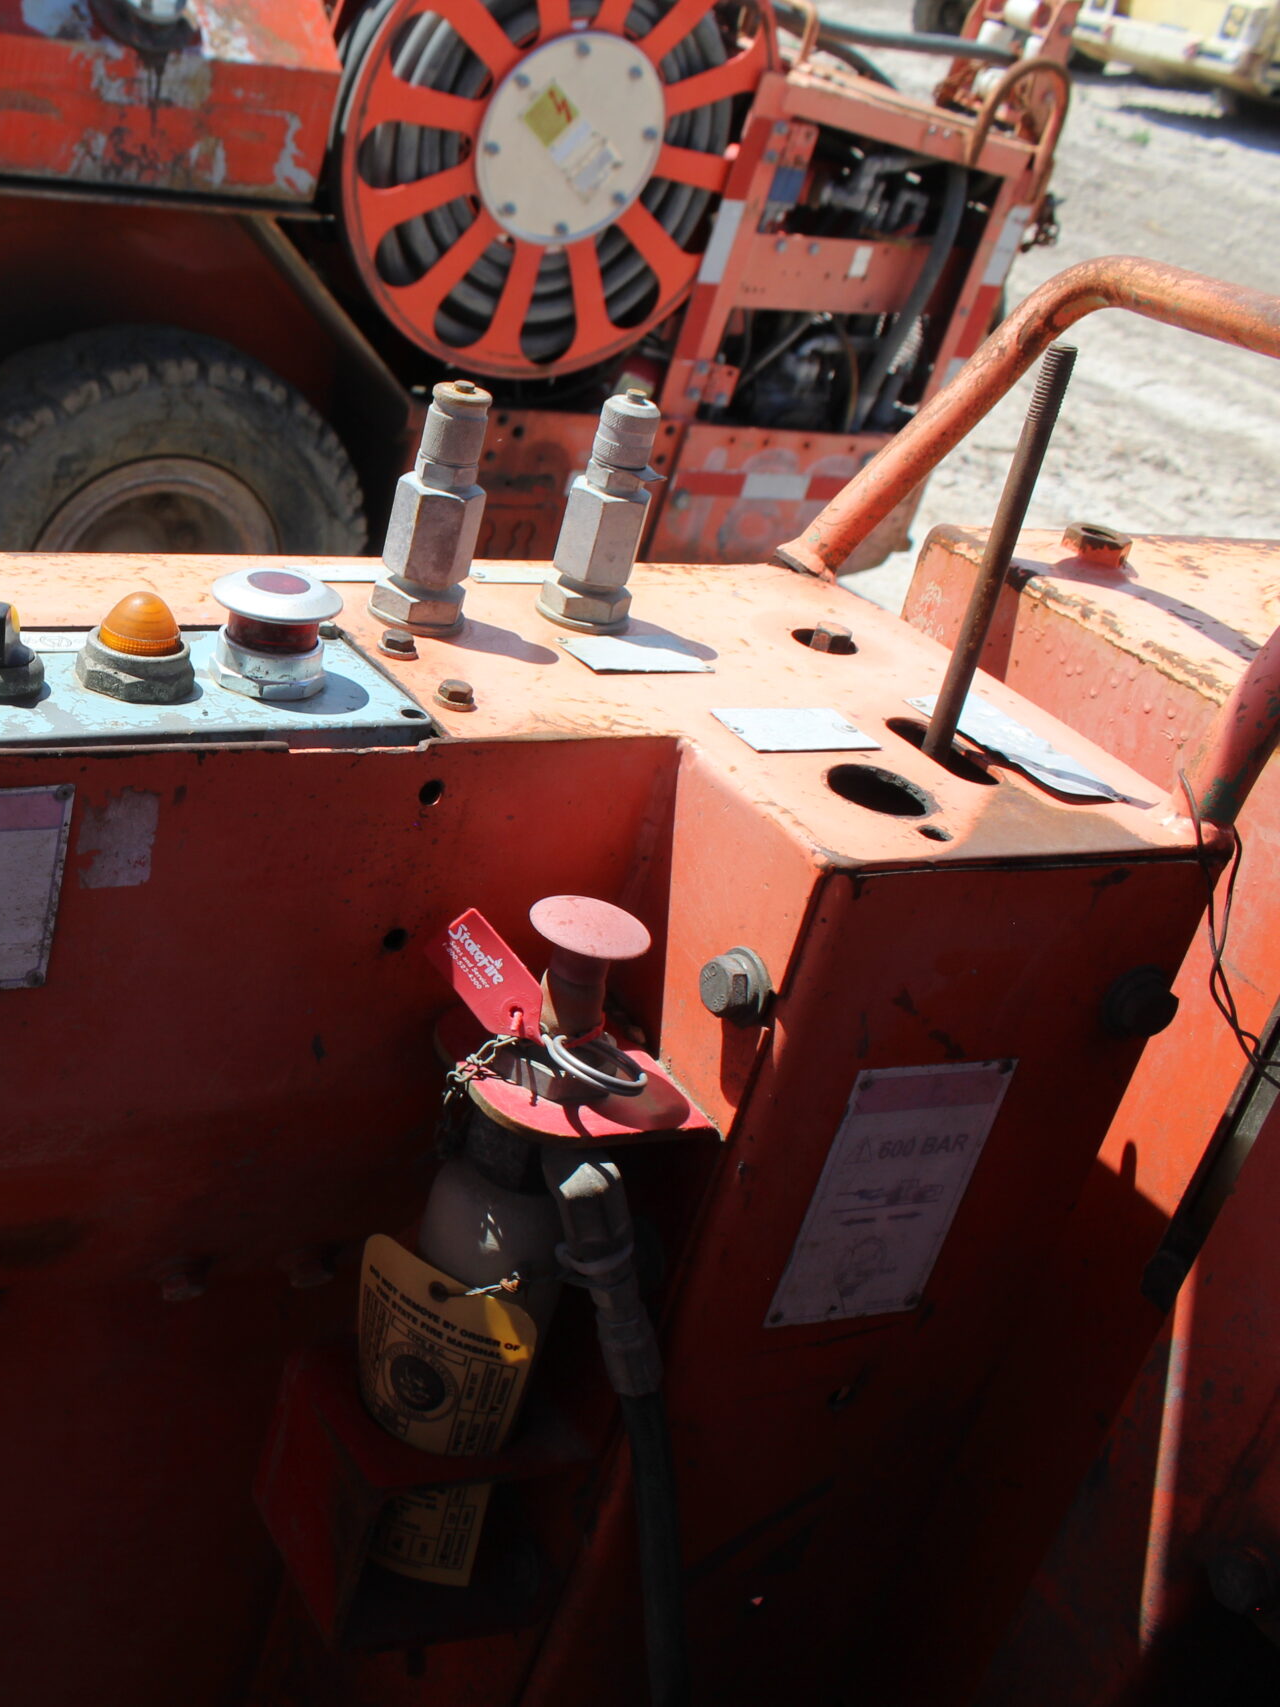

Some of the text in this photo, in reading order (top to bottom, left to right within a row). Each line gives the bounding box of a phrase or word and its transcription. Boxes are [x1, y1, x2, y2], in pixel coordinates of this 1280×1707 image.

[448, 923, 504, 985] StateFire
[462, 957, 475, 968] and
[922, 1133, 969, 1156] BAR
[375, 1284, 391, 1302] THE
[392, 1300, 418, 1325] STATE
[420, 1321, 444, 1339] FIRE
[447, 1336, 503, 1360] MARSHAL
[382, 1278, 398, 1294] NOT
[400, 1294, 441, 1323] REMOVE
[443, 1320, 458, 1332] BY
[460, 1329, 502, 1348] ORDER
[504, 1342, 521, 1352] OF
